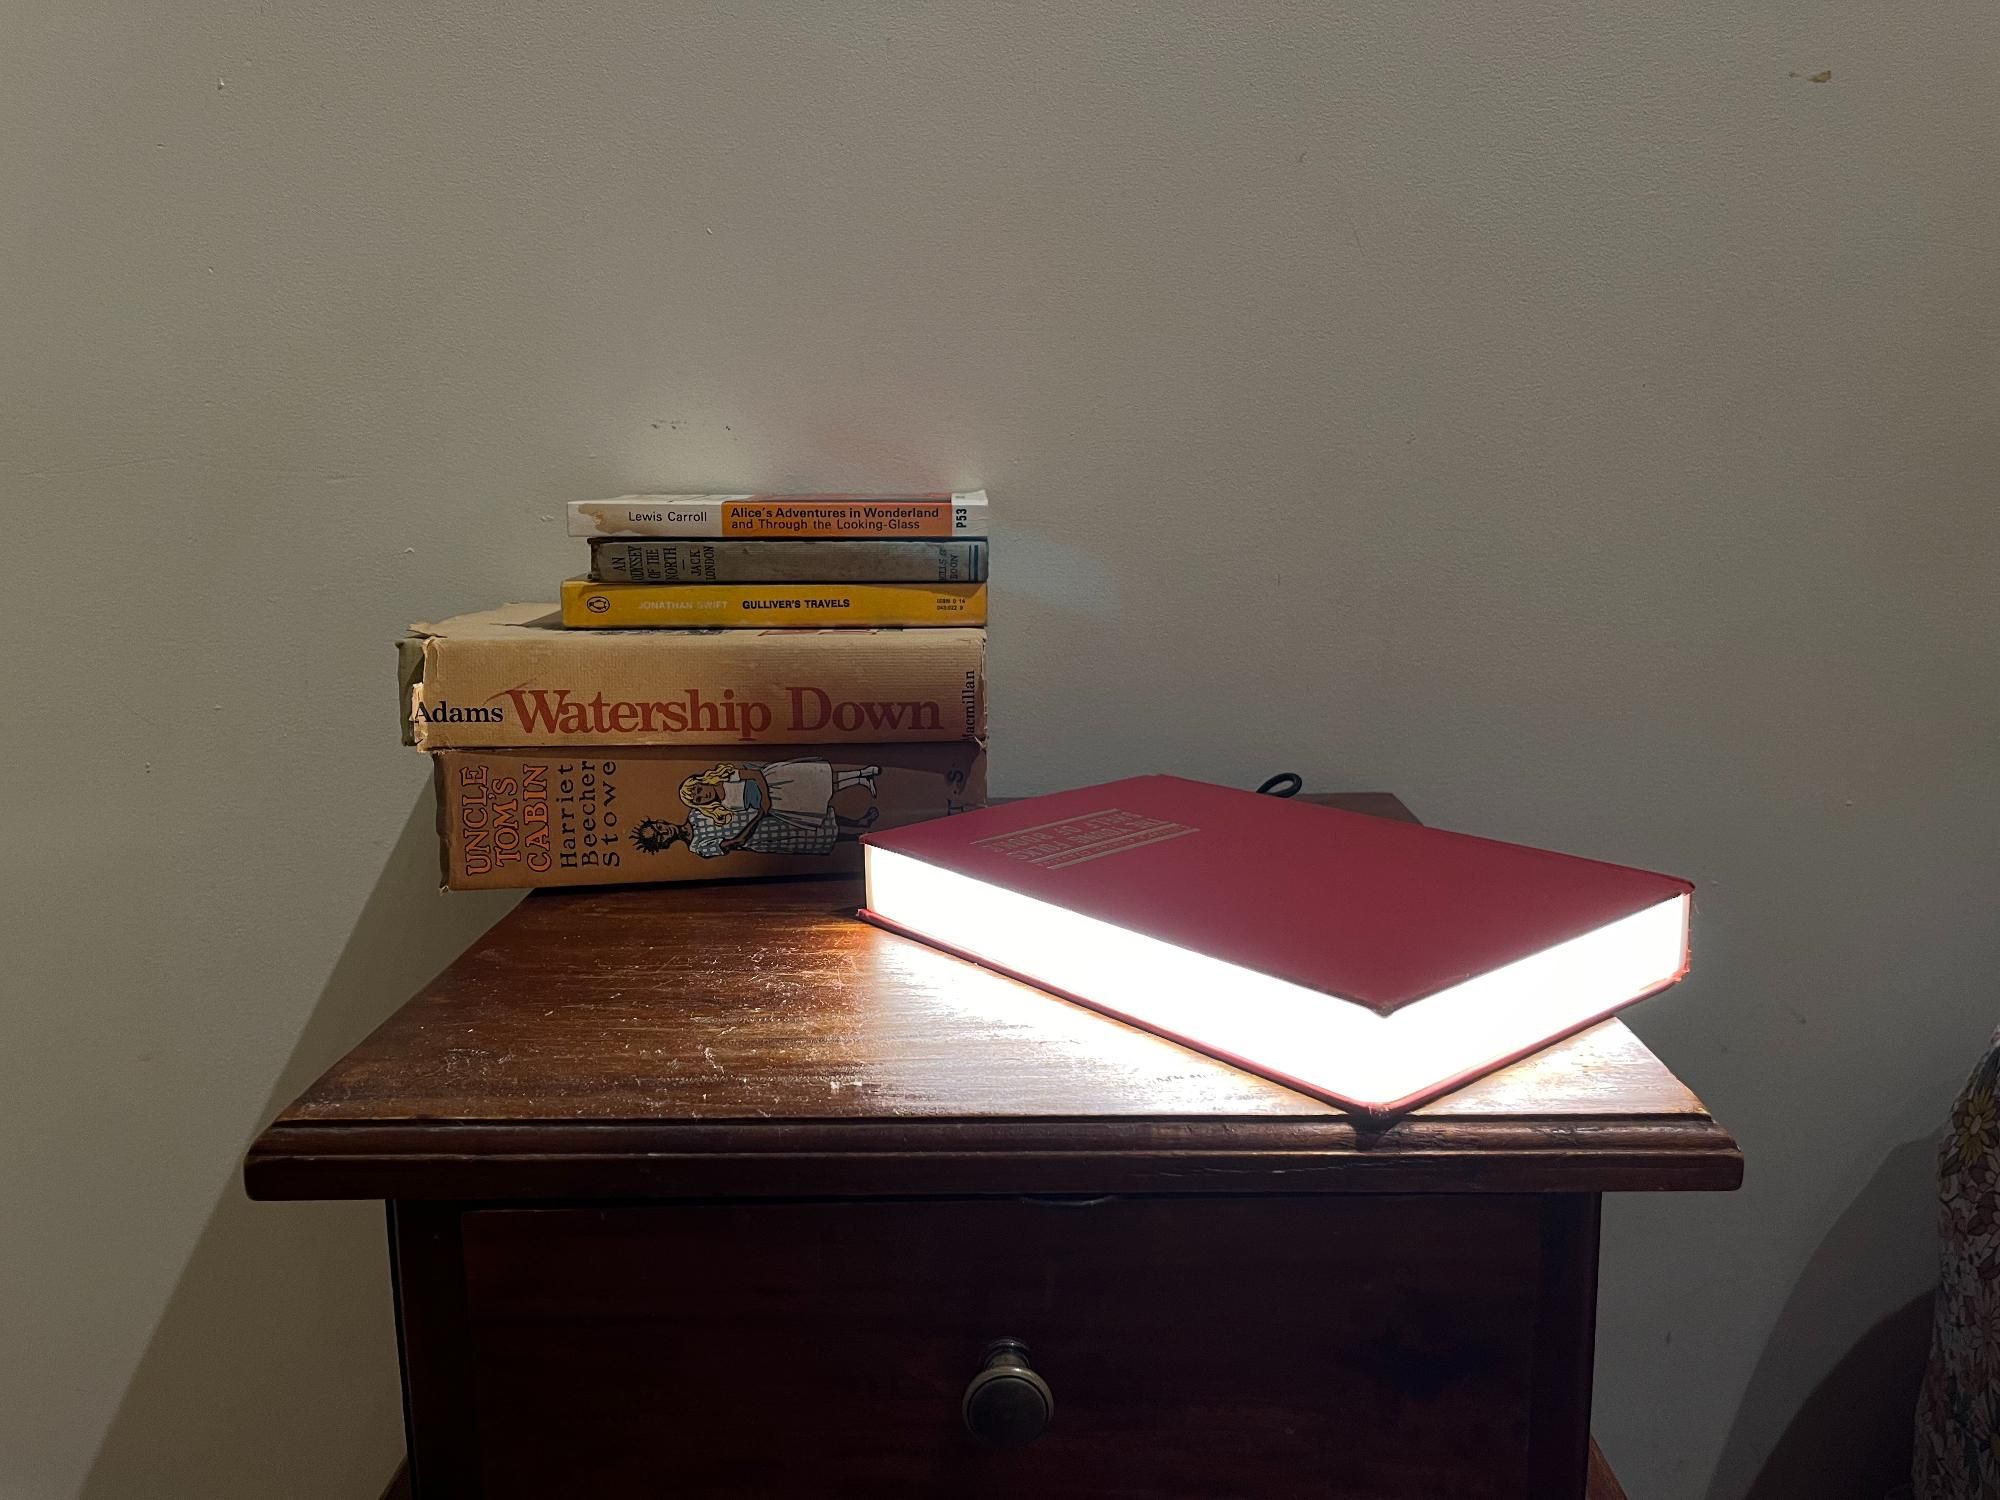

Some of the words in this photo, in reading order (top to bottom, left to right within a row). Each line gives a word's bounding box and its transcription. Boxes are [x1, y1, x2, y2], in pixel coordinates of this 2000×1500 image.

[628, 511, 663, 522] Lewis
[667, 511, 708, 522] Carroll
[730, 507, 773, 518] Alice's
[775, 507, 846, 518] Adventures
[849, 507, 861, 518] in
[864, 507, 939, 518] Wonderland
[731, 519, 754, 529] and
[758, 519, 808, 532] Through
[813, 519, 832, 529] the
[837, 518, 920, 531] Looking-Glass
[956, 508, 967, 528] P53
[612, 556, 626, 571] AN
[627, 545, 644, 581] ODYSSEY
[646, 549, 660, 565] THE
[663, 547, 679, 580] NORTH
[690, 549, 702, 577] JACK
[703, 546, 717, 581] LONDON
[647, 568, 661, 579] OF
[639, 600, 693, 610] JONATHAN
[696, 600, 728, 610] SWIFT
[742, 599, 801, 610] GULLIVER'S
[804, 598, 850, 609] TRAVELS
[413, 700, 505, 724] Adams
[484, 686, 772, 741] Watership
[786, 687, 945, 731] Down
[459, 765, 492, 876] UNCLE
[488, 777, 522, 867] TOM'S
[523, 764, 553, 873] CABIN
[556, 763, 578, 868] Harriet
[579, 760, 599, 866] Beecher
[601, 761, 621, 867] Stowe
